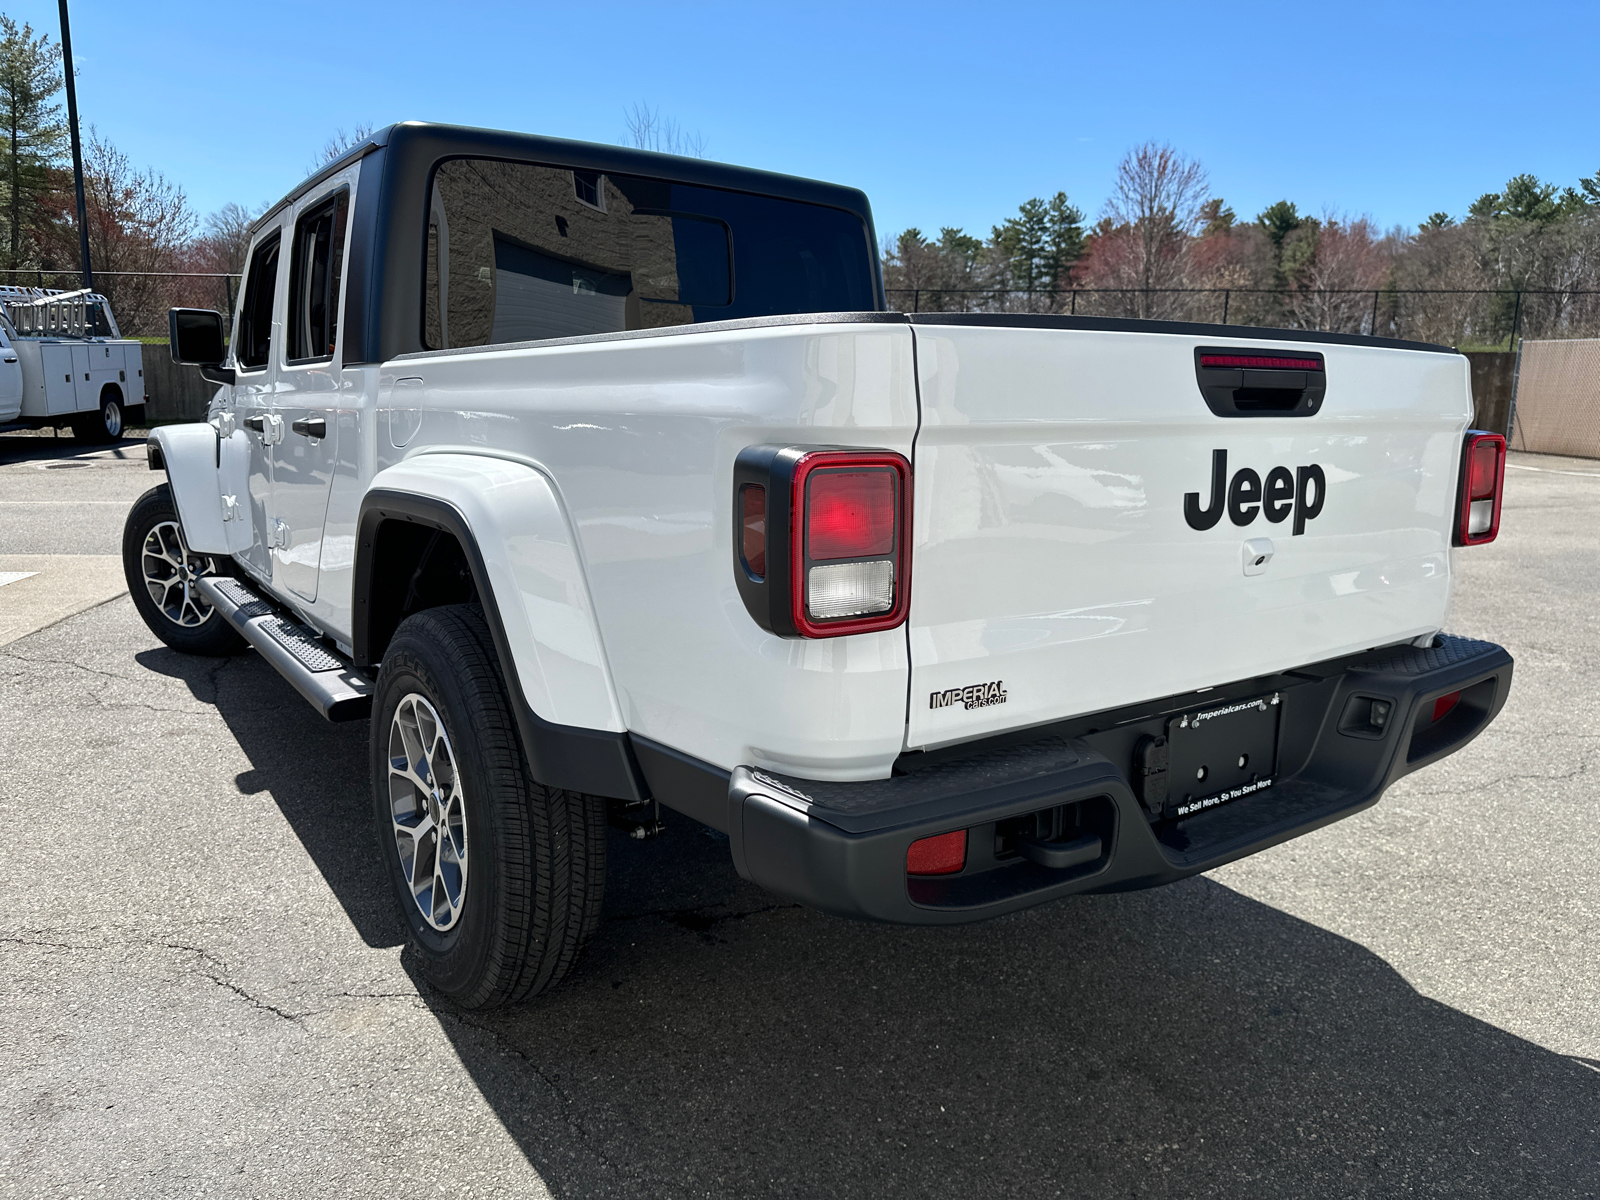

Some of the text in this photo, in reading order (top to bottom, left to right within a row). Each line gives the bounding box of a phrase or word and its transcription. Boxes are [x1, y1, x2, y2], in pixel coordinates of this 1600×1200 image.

[1184, 448, 1326, 536] Jeep
[930, 680, 1008, 709] IMPERIAL
[1196, 699, 1263, 720] Imperialcars.com
[1178, 779, 1272, 815] We Sell More, So You Save More
